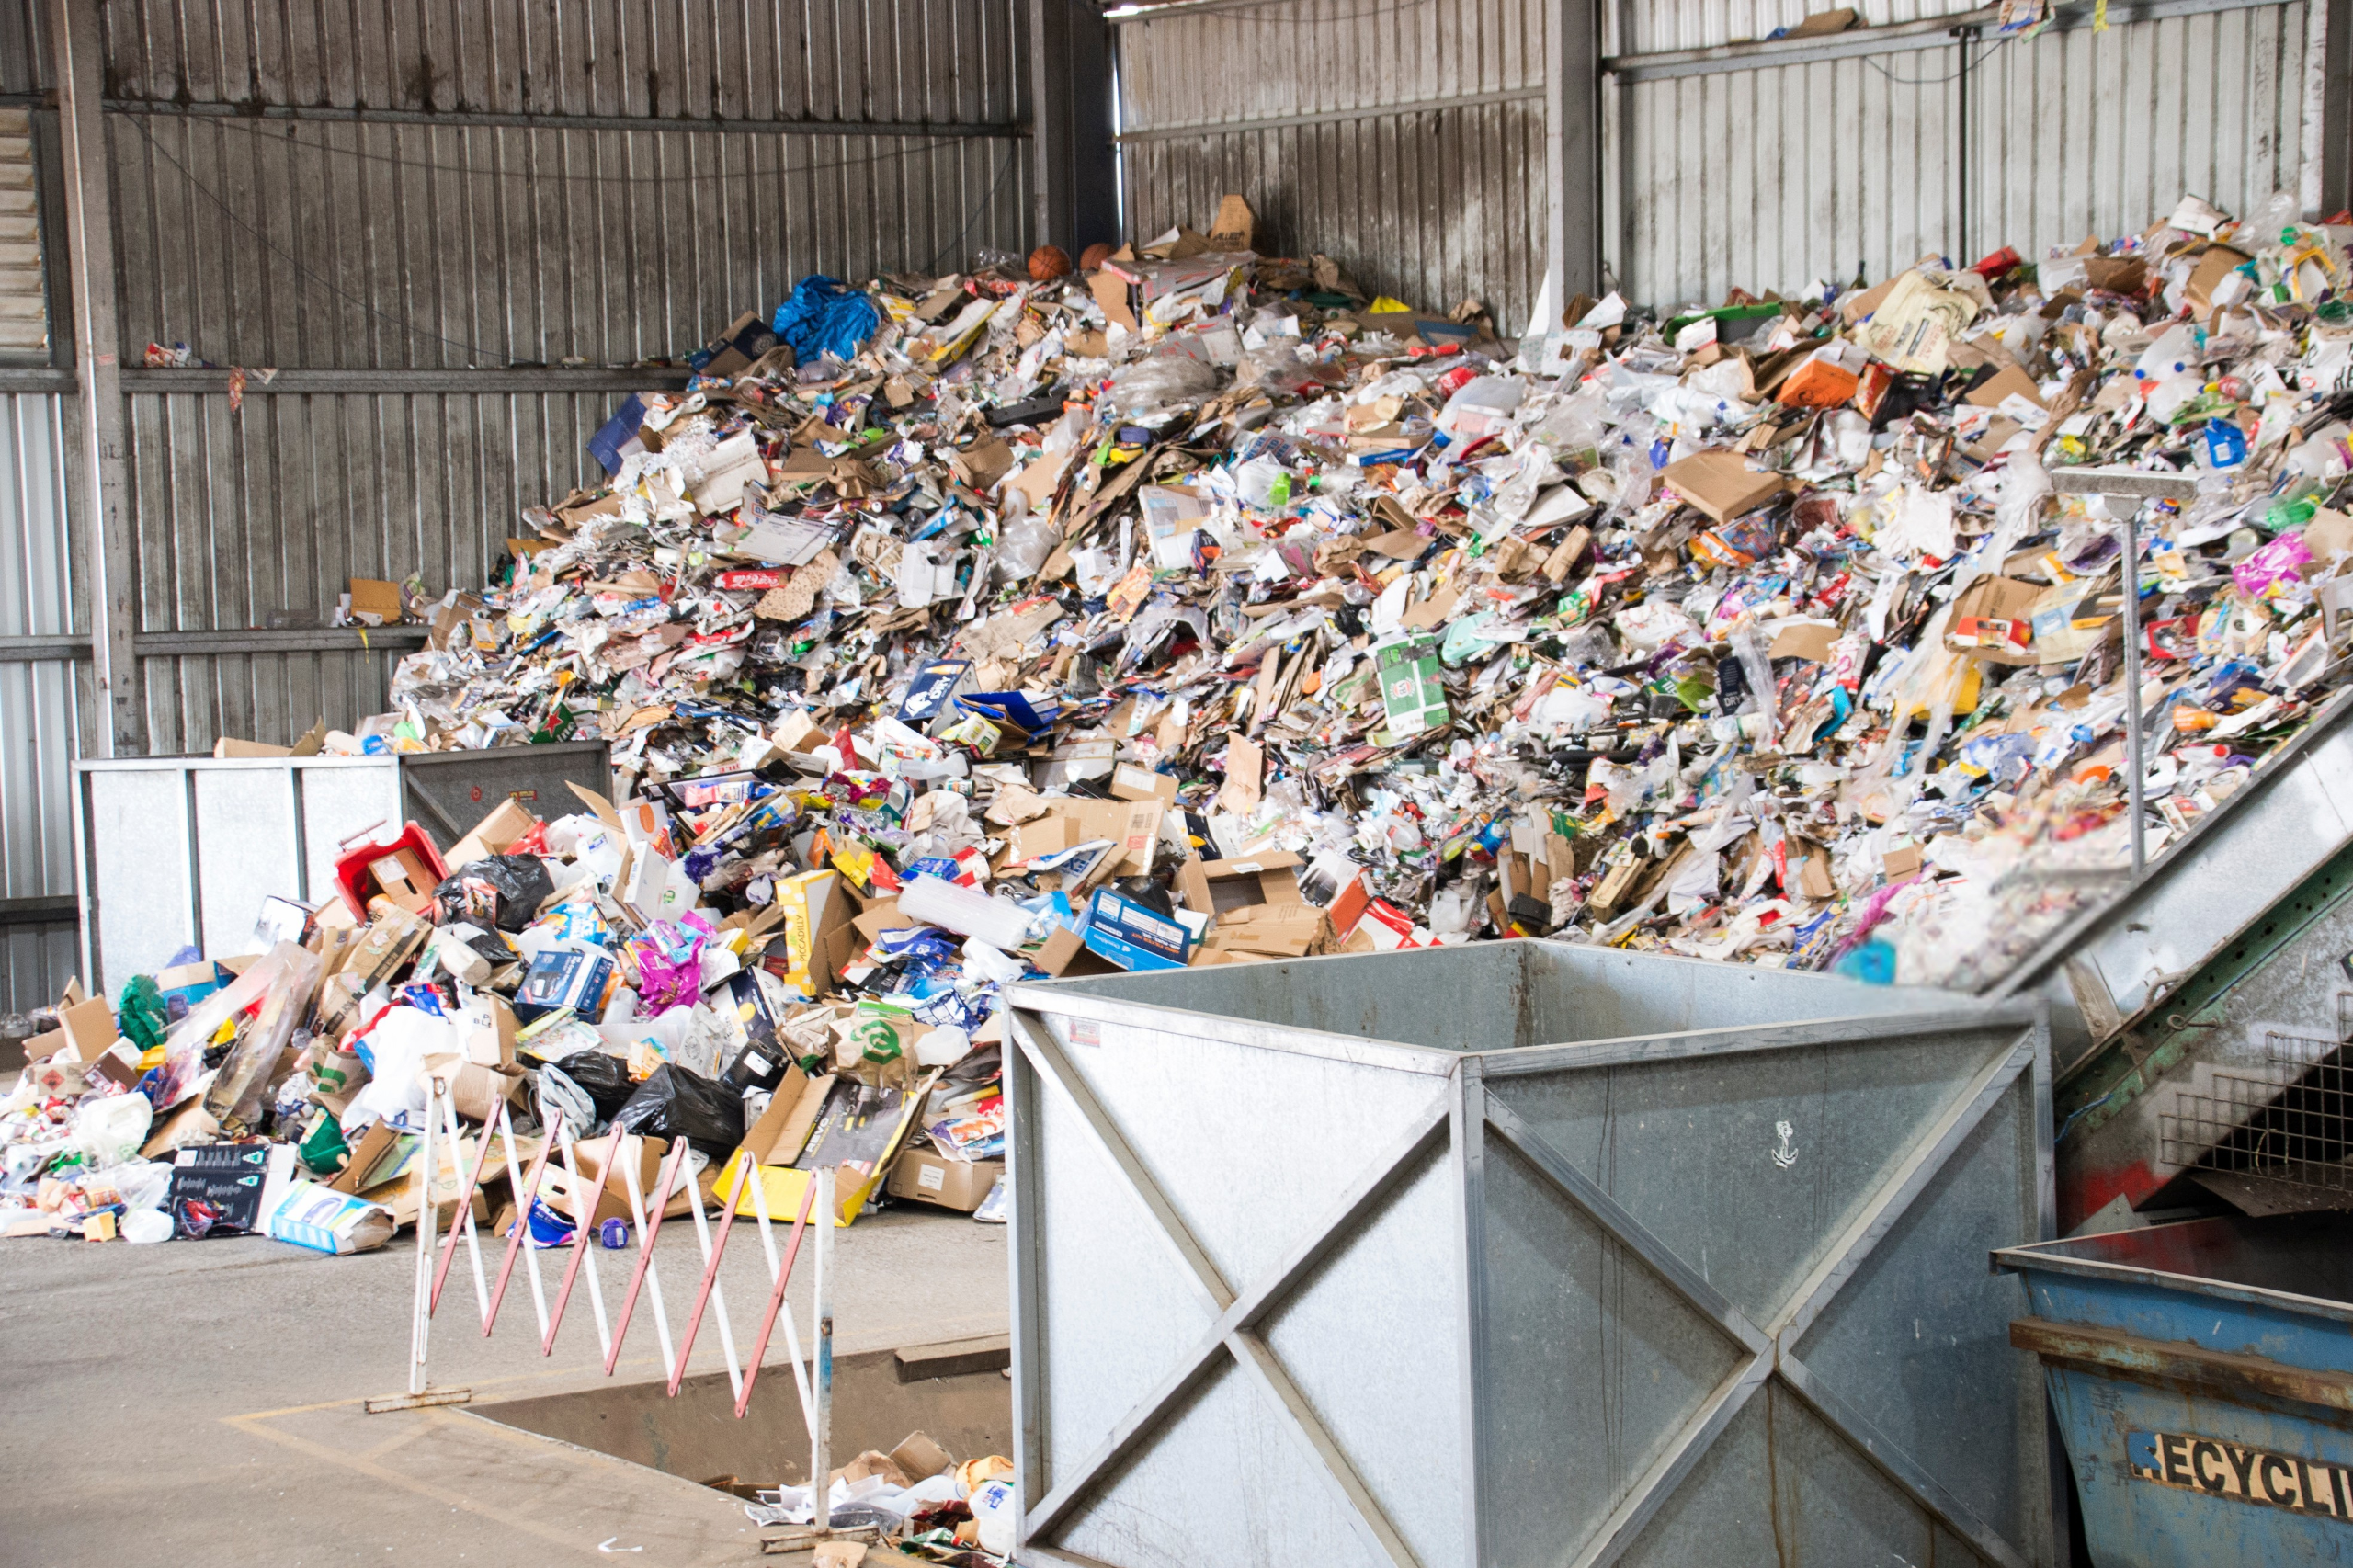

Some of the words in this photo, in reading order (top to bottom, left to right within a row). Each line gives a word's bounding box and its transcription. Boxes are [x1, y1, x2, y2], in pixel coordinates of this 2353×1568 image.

[733, 572, 779, 589] Coca-Cola
[929, 676, 950, 699] DRY
[1398, 682, 1407, 694] VB
[1723, 696, 1740, 708] DRY
[798, 915, 807, 962] PICCADILLY
[805, 1117, 829, 1153] REVO
[2135, 1433, 2353, 1518] ECYCLI
